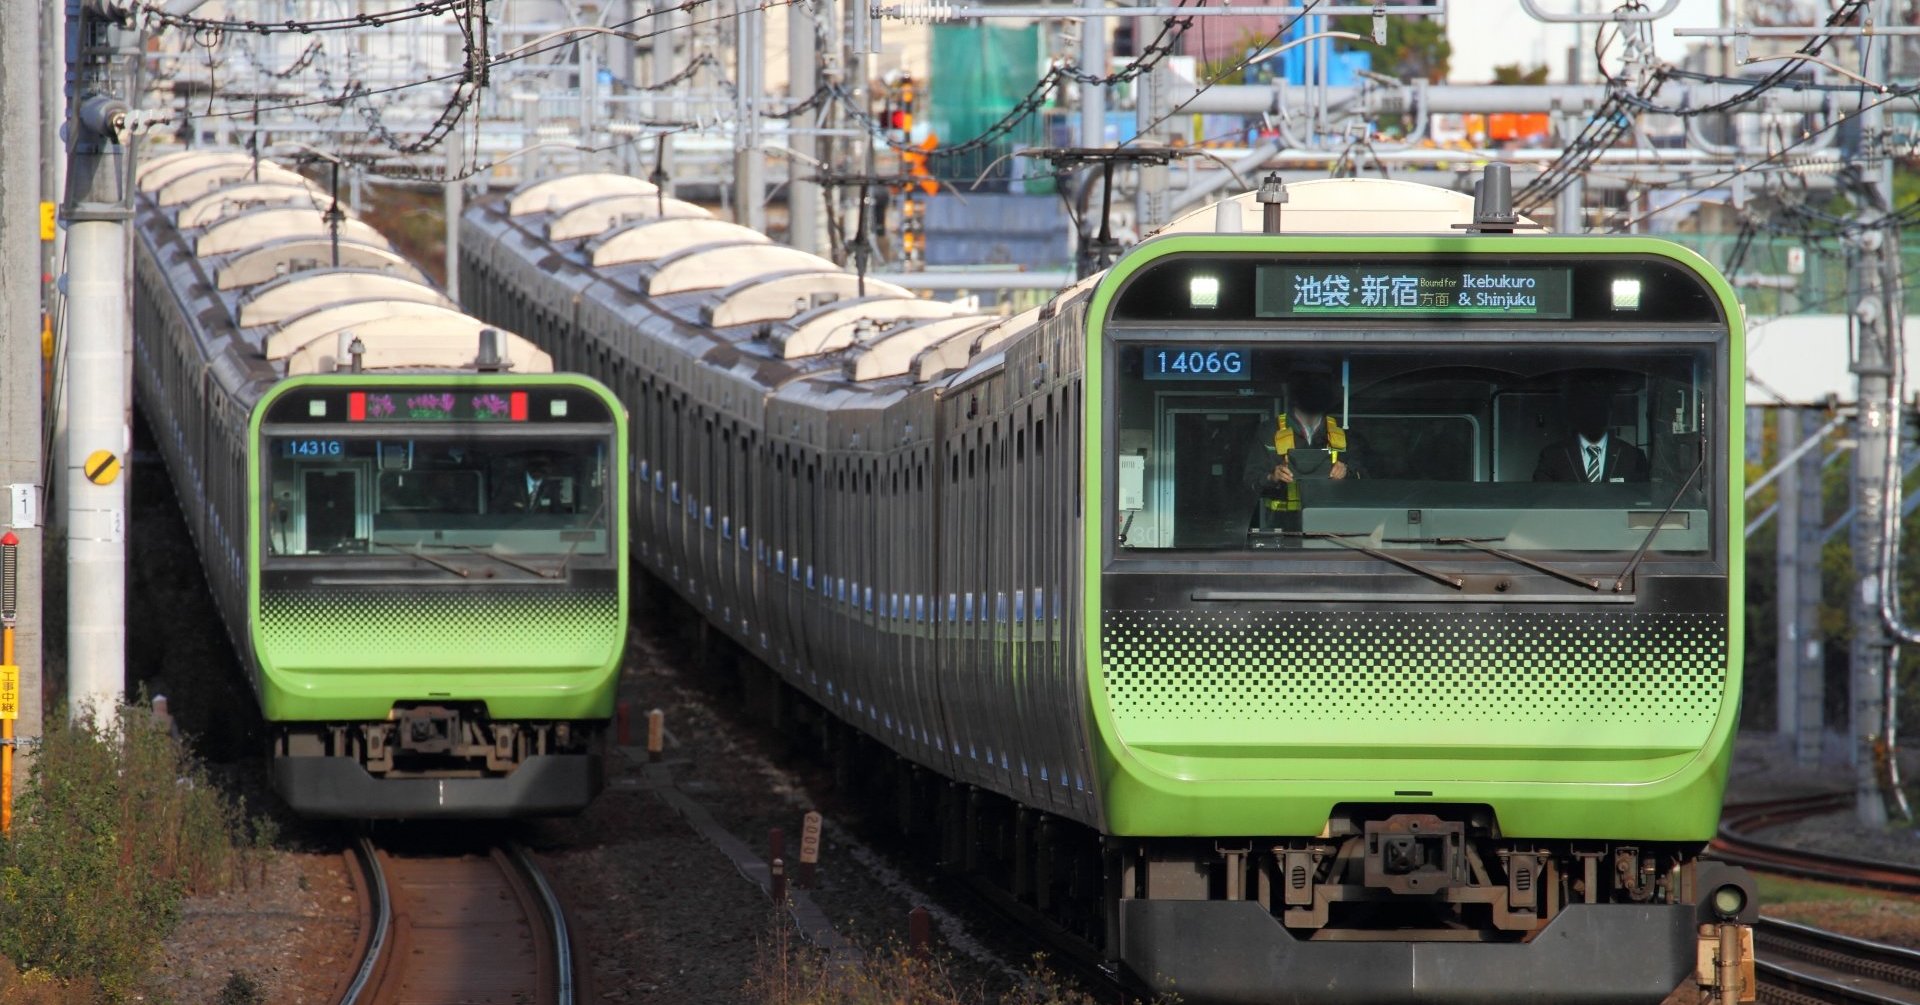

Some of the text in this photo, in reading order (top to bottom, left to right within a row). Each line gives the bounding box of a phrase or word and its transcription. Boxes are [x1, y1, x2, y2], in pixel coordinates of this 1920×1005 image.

[1420, 277, 1457, 288] Bound for
[1462, 274, 1536, 288] Ikebukuro
[1419, 292, 1449, 307] 方面
[1458, 292, 1536, 310] & Shinjuku
[1157, 351, 1242, 374] 1406G
[290, 440, 341, 456] 1431G
